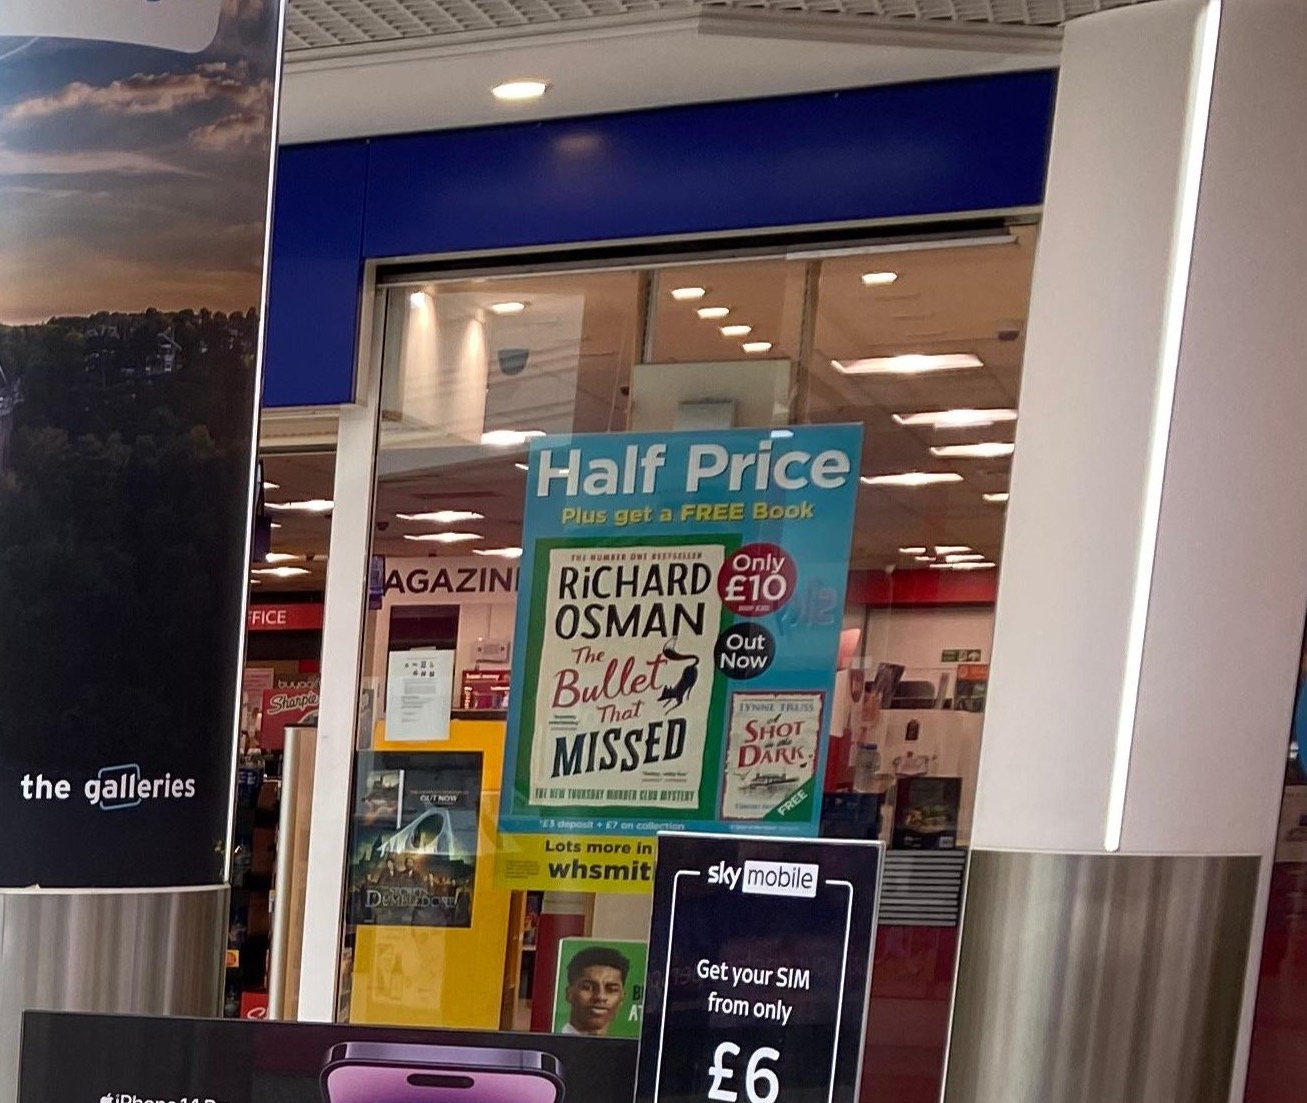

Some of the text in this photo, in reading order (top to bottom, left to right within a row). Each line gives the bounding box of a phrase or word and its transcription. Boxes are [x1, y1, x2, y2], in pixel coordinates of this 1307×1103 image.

[536, 440, 851, 497] Half Price
[561, 501, 815, 526] Plus get a FREE Book
[733, 553, 785, 572] Only
[384, 566, 520, 593] AGAZIN
[724, 576, 787, 602] £10
[555, 602, 705, 640] OSMAN
[571, 645, 605, 664] The
[726, 634, 766, 651] Out
[720, 652, 769, 670] Now
[551, 653, 668, 709] Bullet
[596, 700, 644, 724] That
[744, 720, 806, 743] SHOT
[550, 718, 687, 779] MISSED
[737, 744, 804, 768] DARK
[21, 772, 196, 805] the galleries
[777, 789, 809, 816] FREE
[545, 839, 652, 854] Lots more in
[707, 860, 814, 892] sky mobile
[696, 959, 811, 991] Get your SIM
[708, 991, 793, 1026] from only
